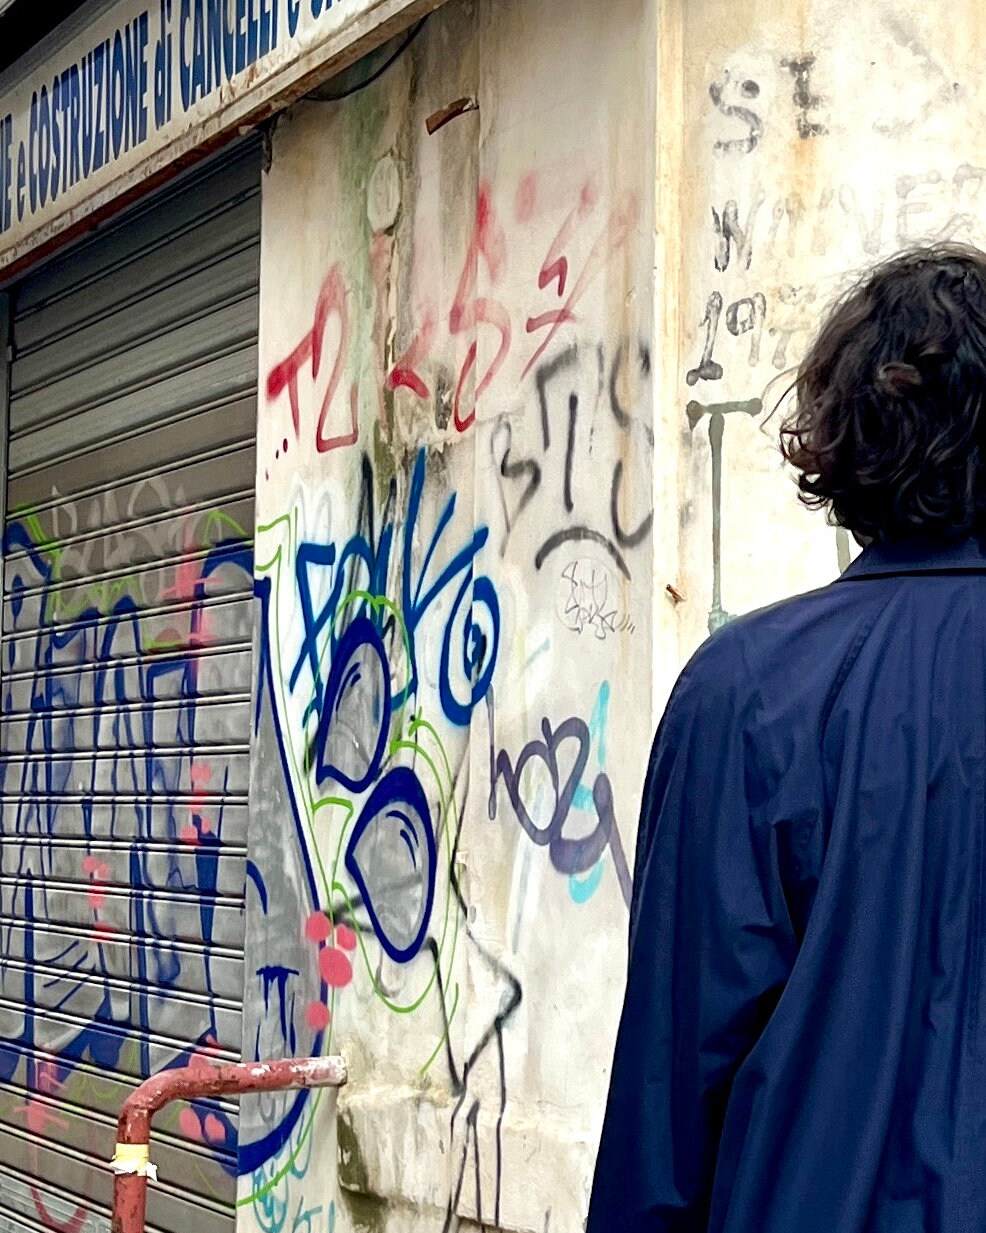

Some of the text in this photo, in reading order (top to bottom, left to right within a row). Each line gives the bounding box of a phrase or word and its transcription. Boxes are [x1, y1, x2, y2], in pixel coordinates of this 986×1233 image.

[17, 140, 27, 223] e
[29, 10, 149, 215] COSTRUZIONE
[154, 0, 172, 131] di
